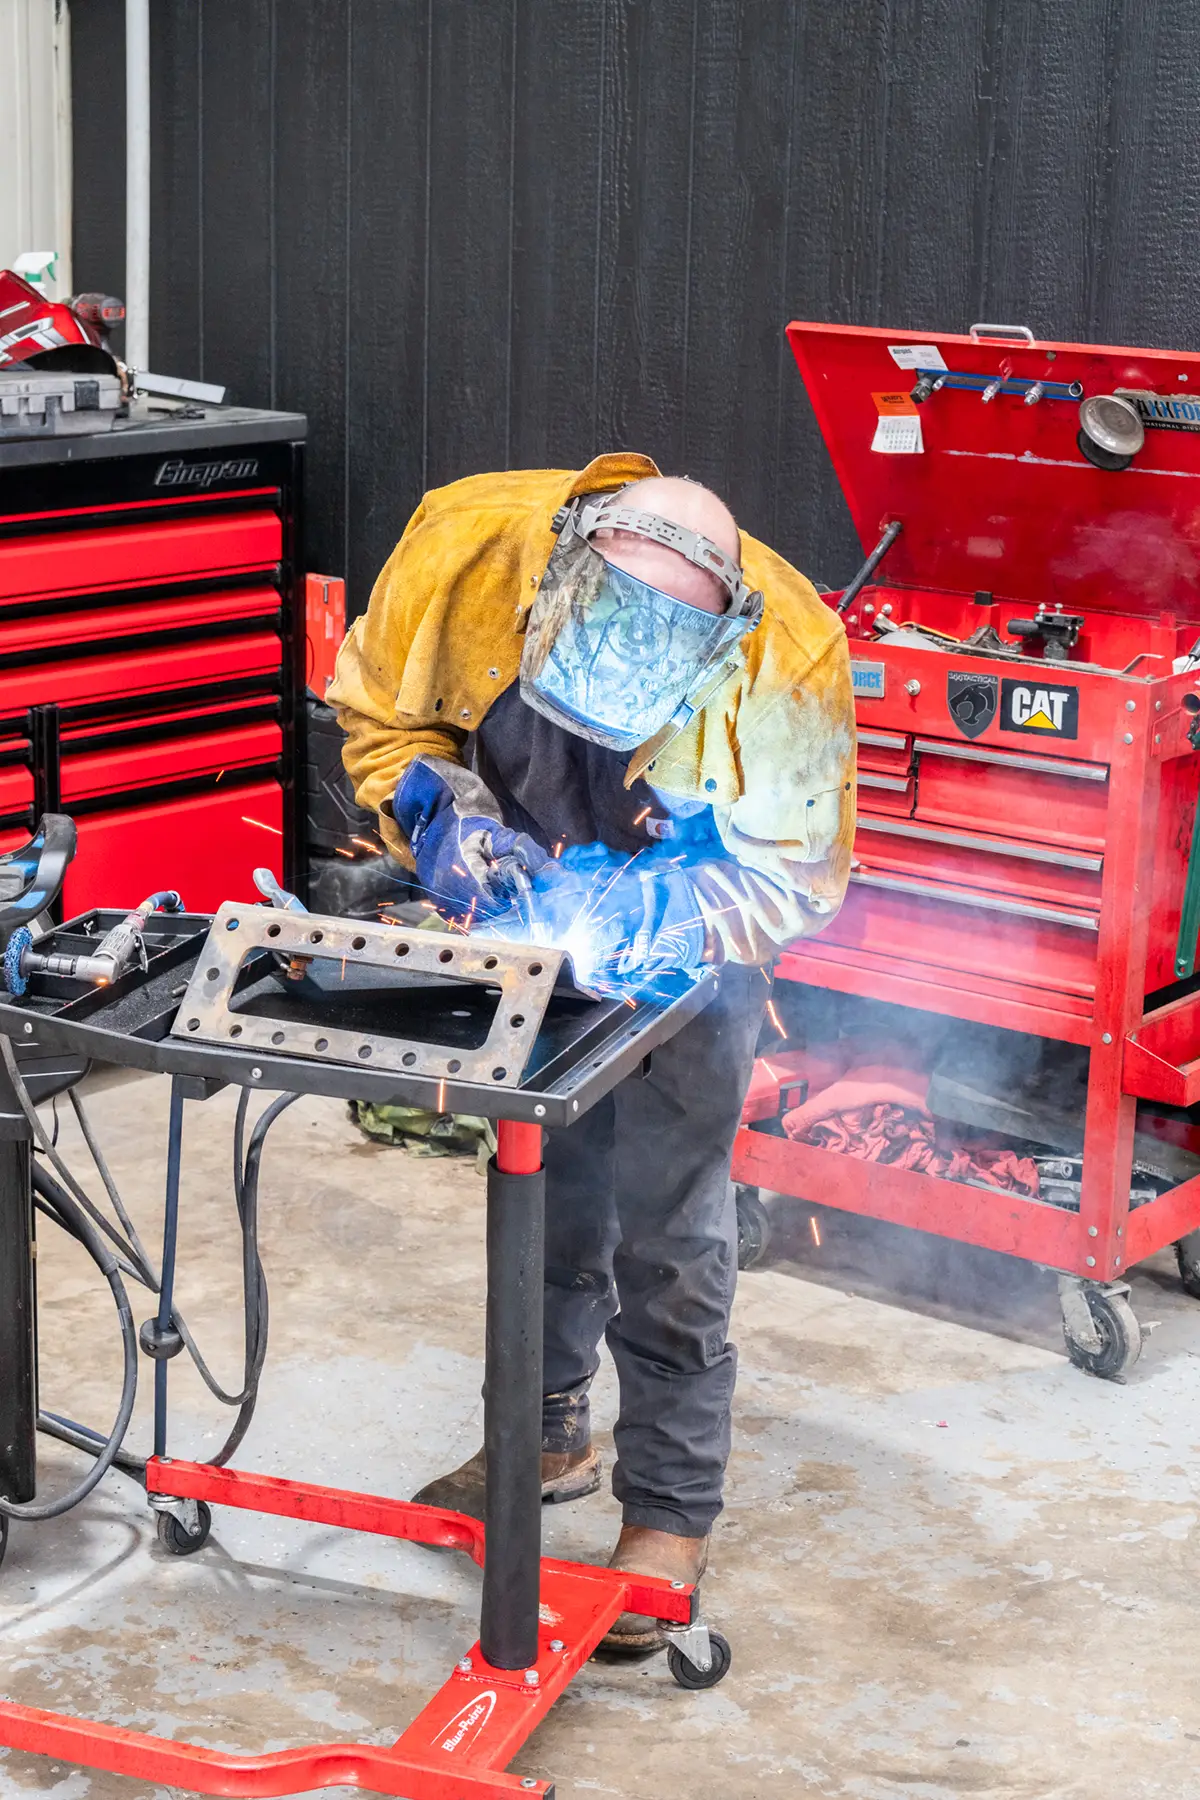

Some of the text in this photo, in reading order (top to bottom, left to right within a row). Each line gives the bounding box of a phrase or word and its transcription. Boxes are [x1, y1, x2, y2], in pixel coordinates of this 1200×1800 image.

[1126, 398, 1200, 420] AXXFO
[1011, 686, 1070, 731] CAT
[441, 1704, 486, 1752] Blue-Point
